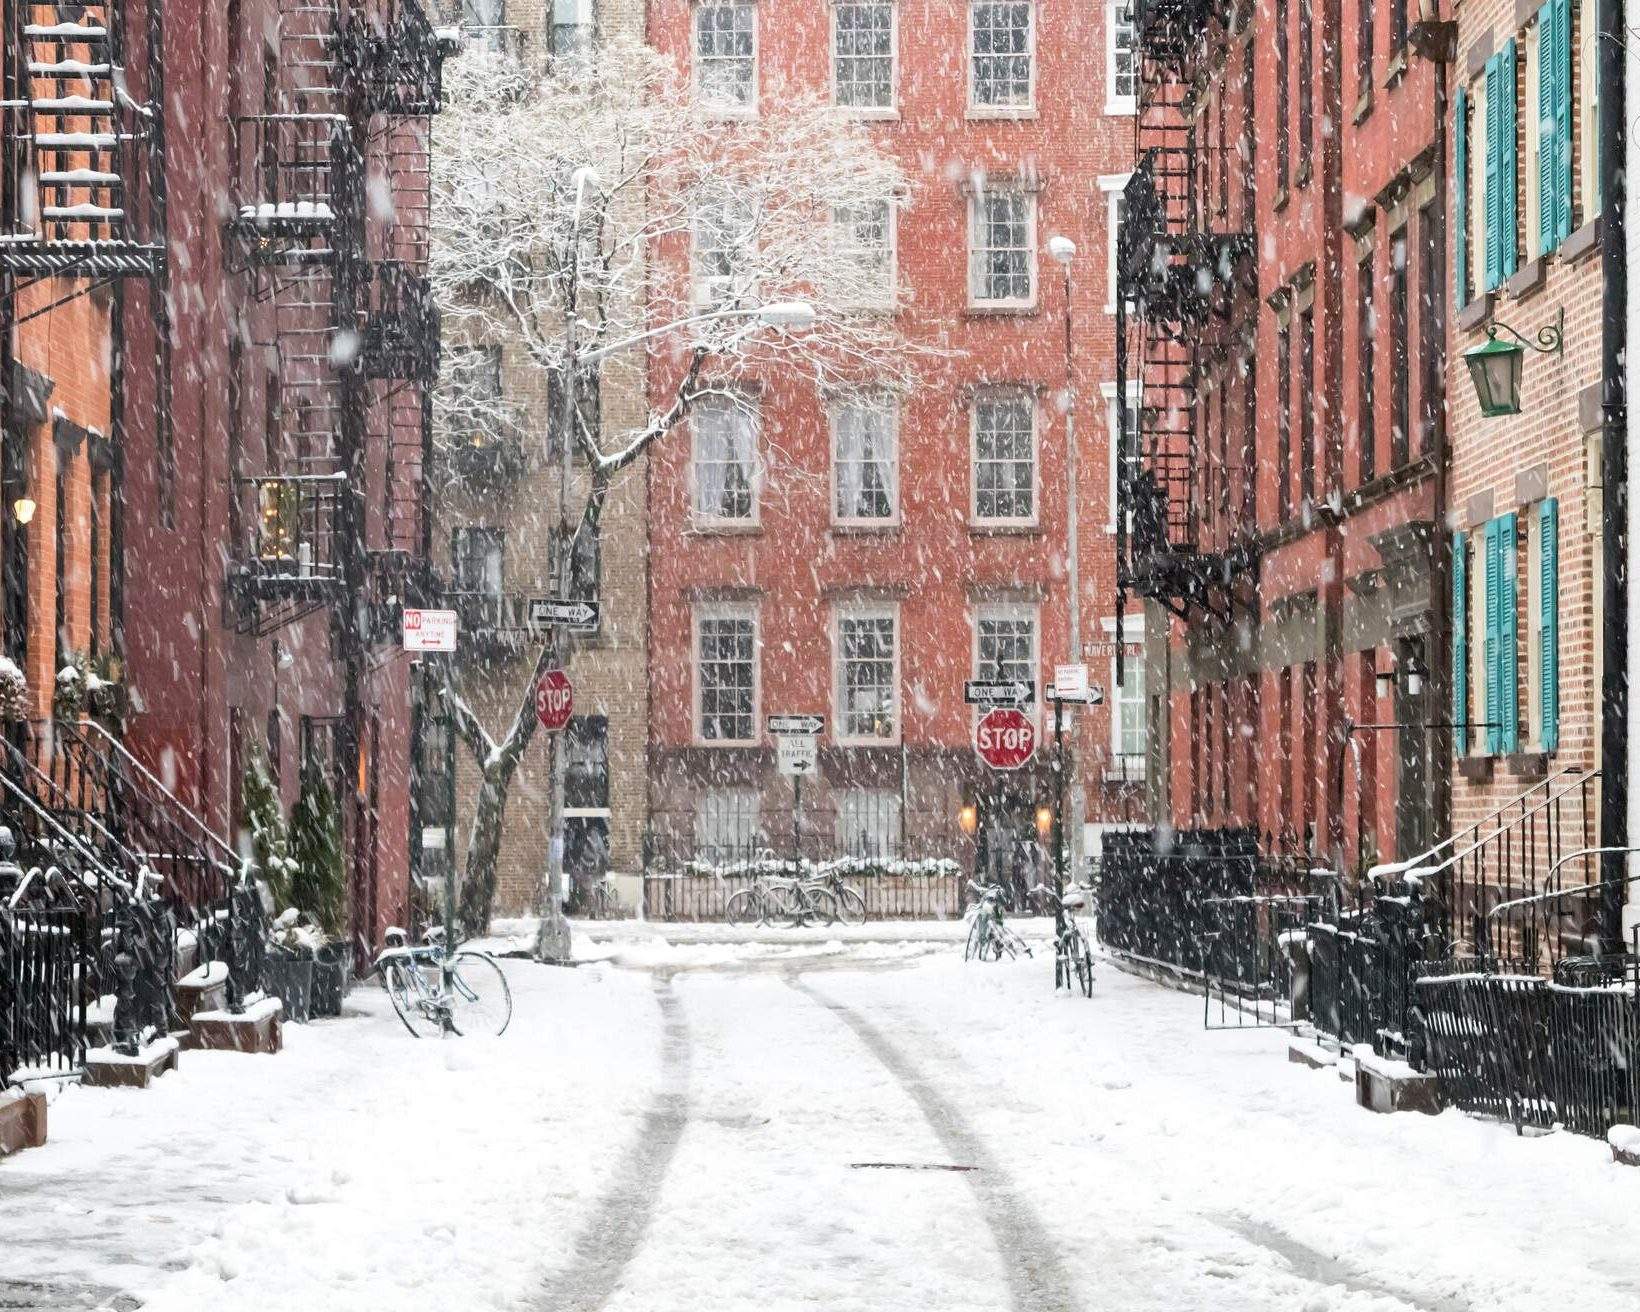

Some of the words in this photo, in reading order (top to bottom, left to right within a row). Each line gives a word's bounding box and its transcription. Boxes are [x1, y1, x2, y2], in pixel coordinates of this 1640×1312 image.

[538, 606, 557, 616] ONE
[569, 607, 588, 618] WAY
[405, 613, 420, 627] NO
[422, 615, 455, 624] PARKING
[1084, 644, 1123, 656] WAVERL
[974, 688, 995, 697] ONE
[538, 688, 570, 713] STOP
[772, 720, 788, 728] ONE
[980, 727, 1031, 751] STOP
[781, 749, 813, 758] TRAFFIC
